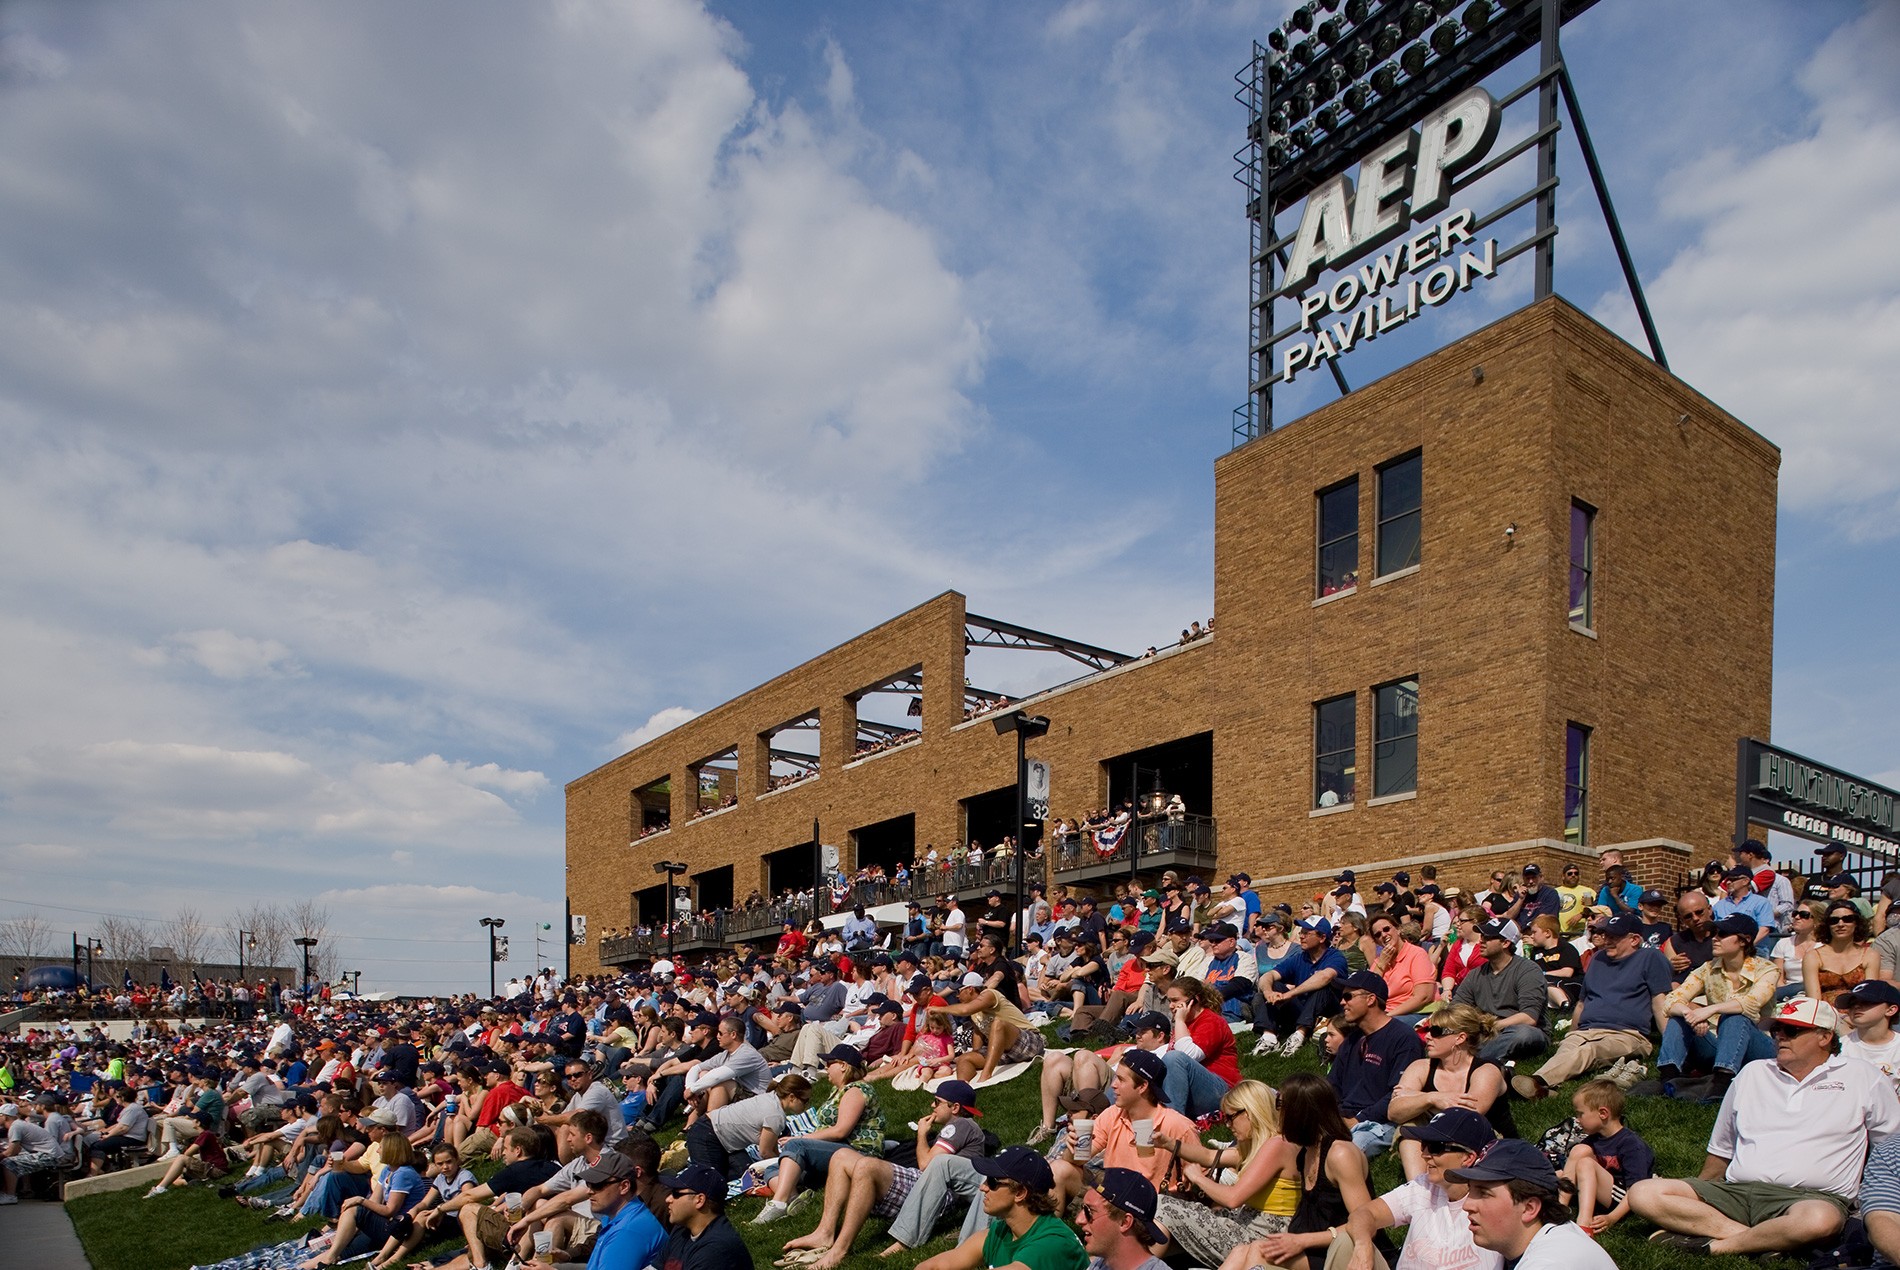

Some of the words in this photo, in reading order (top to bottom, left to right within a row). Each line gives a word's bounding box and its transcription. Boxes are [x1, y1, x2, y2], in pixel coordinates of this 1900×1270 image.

[1280, 86, 1502, 299] AEP
[1299, 207, 1478, 334] POWER
[1282, 237, 1499, 384] PAVILION
[1032, 803, 1050, 821] 32
[1766, 752, 1894, 828] HUNTINGTON
[1783, 810, 1829, 836] CENTER
[1831, 825, 1865, 846] FIELD
[575, 936, 587, 946] 29
[679, 911, 692, 922] 30
